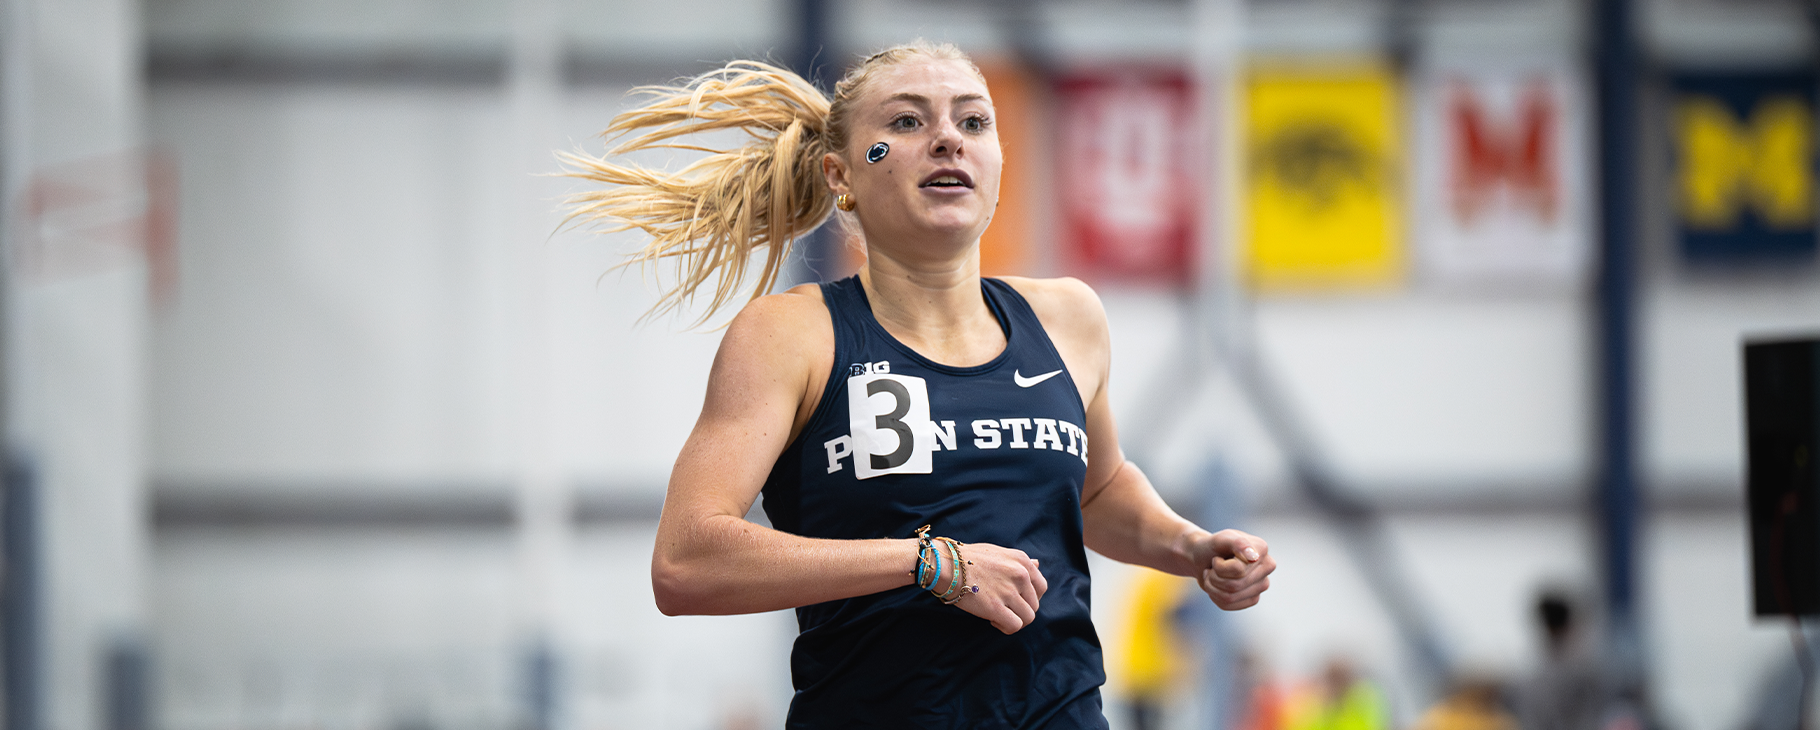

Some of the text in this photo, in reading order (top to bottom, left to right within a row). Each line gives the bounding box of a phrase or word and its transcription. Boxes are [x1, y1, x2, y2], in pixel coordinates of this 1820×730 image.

[1676, 96, 1818, 228] M
[824, 420, 957, 474] PN
[866, 378, 914, 470] 3
